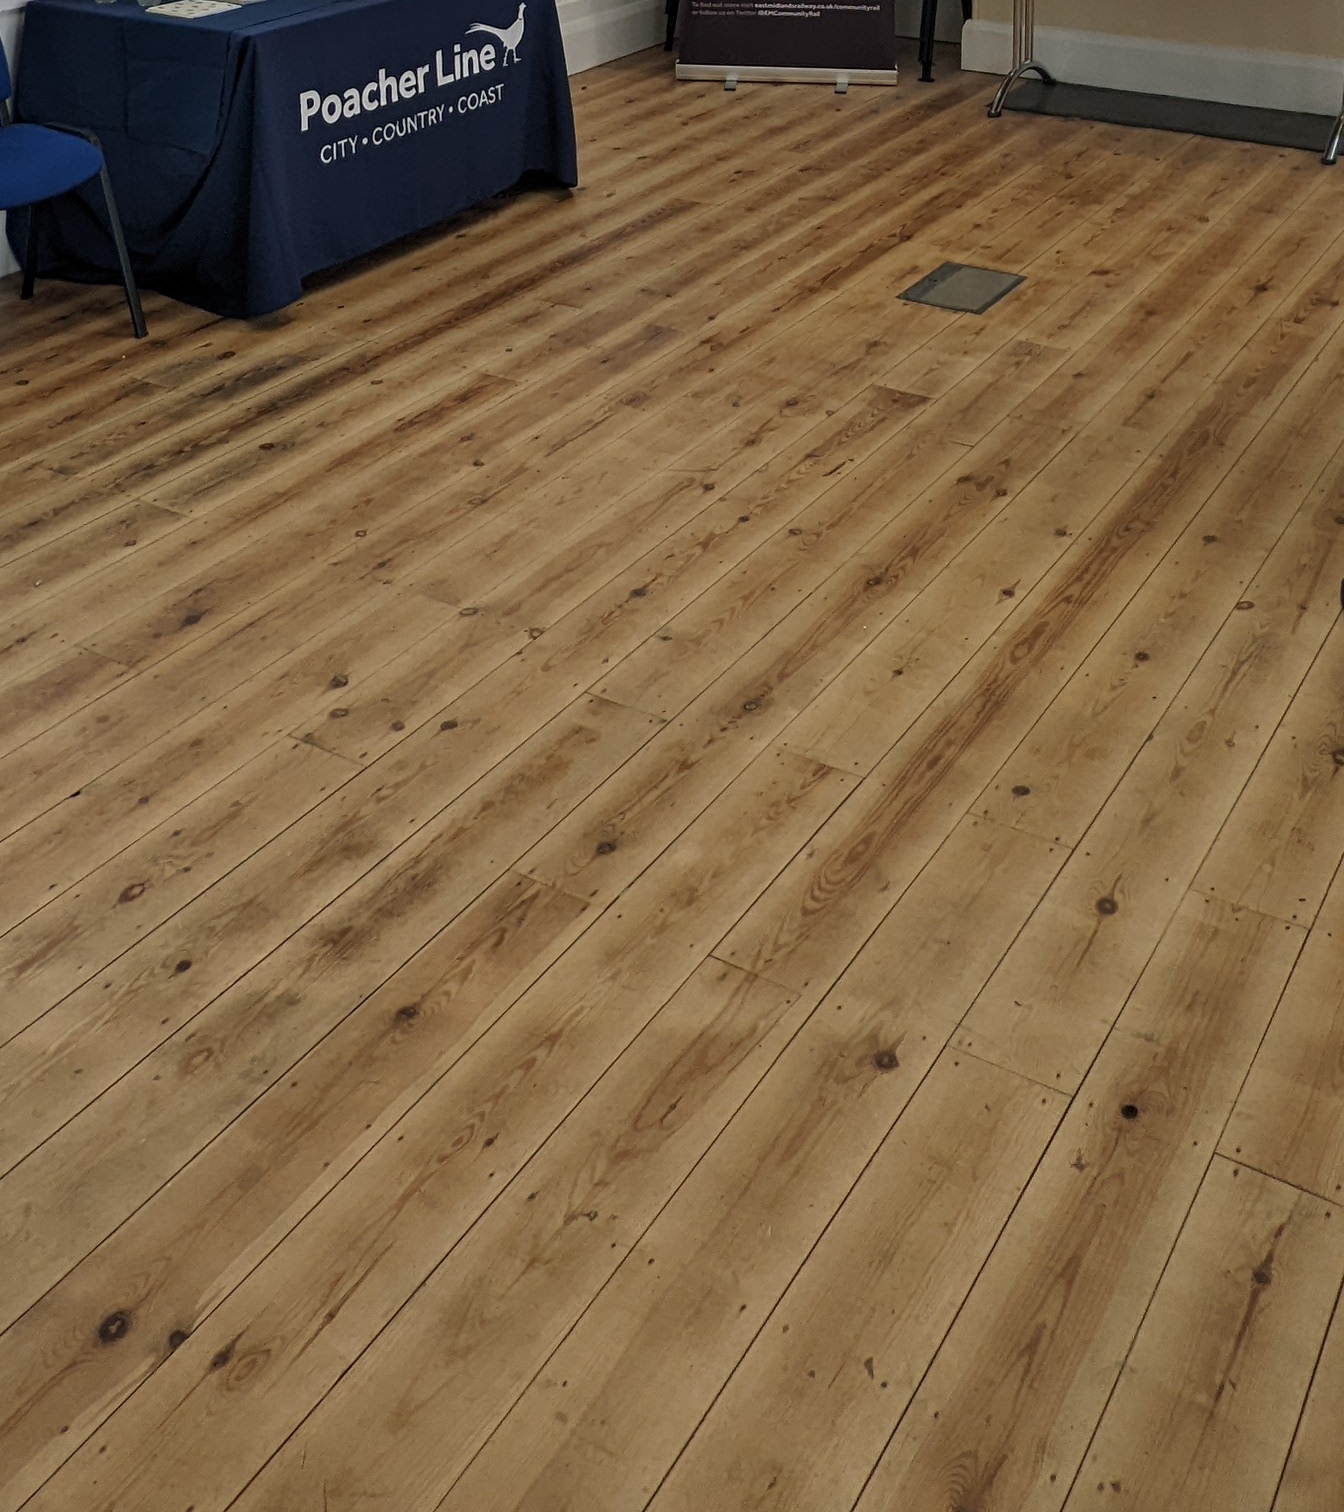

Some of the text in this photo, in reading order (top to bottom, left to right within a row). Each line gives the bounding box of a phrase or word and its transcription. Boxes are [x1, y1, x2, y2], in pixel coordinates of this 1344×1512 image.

[299, 43, 496, 132] Poacher Line
[320, 83, 505, 164] CITY COUNTRY COAST
